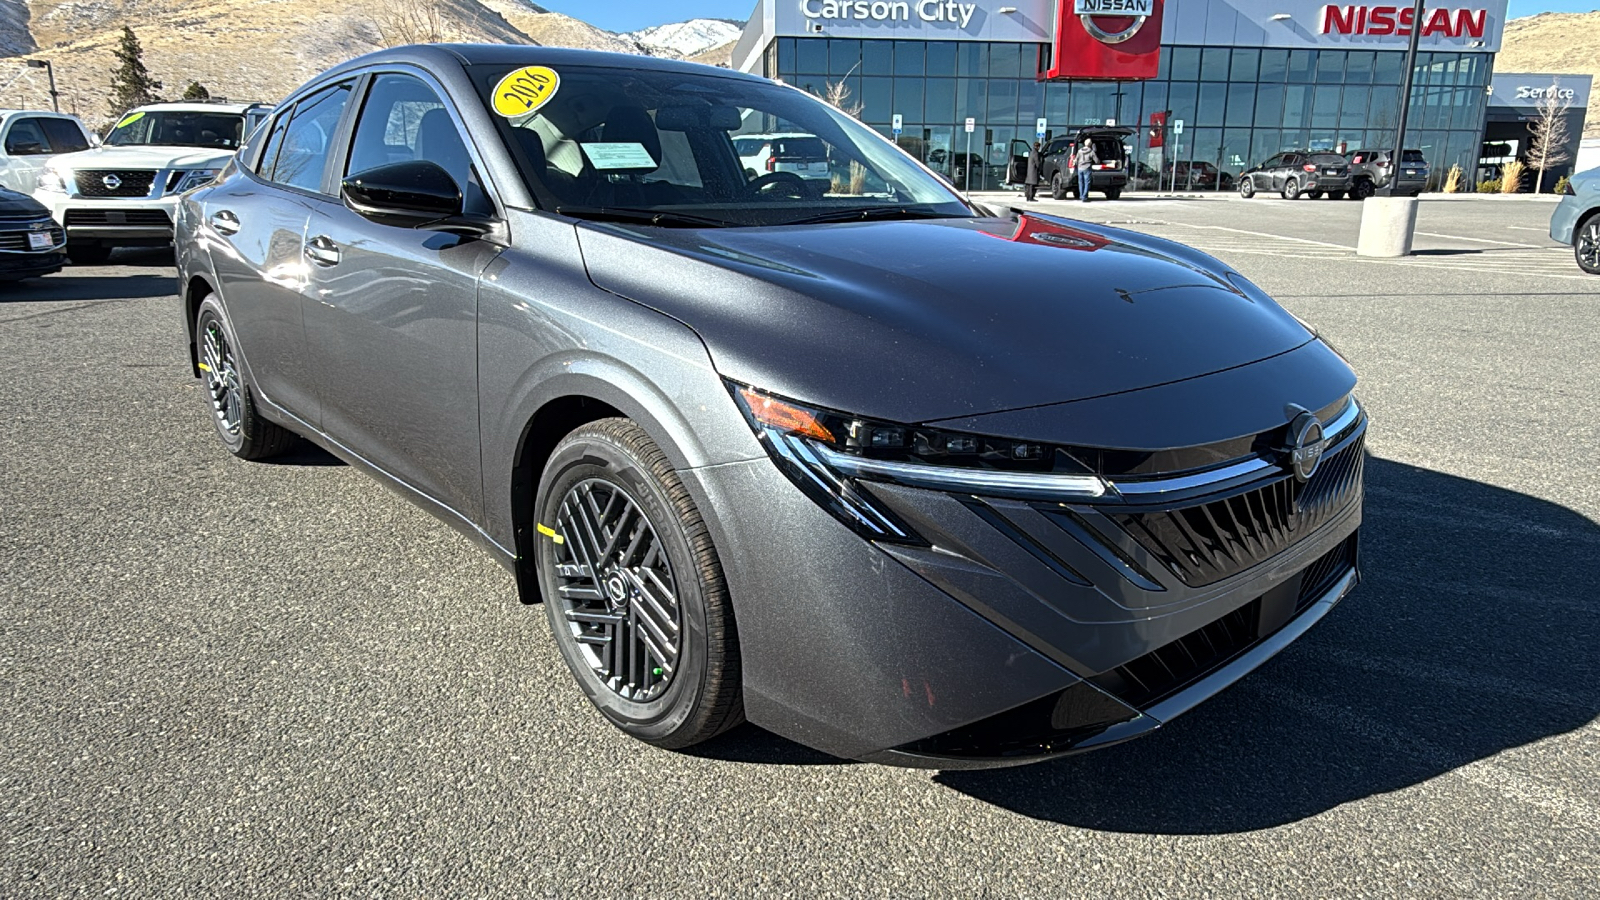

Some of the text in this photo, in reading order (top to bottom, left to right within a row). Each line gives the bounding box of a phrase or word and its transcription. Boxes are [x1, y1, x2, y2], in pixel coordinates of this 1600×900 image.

[801, 0, 976, 28] Carson City
[1083, 0, 1147, 11] NISSAN
[1323, 4, 1487, 37] NISSAN
[503, 69, 550, 108] 2026
[1518, 85, 1575, 99] Service
[1084, 117, 1101, 126] 2750
